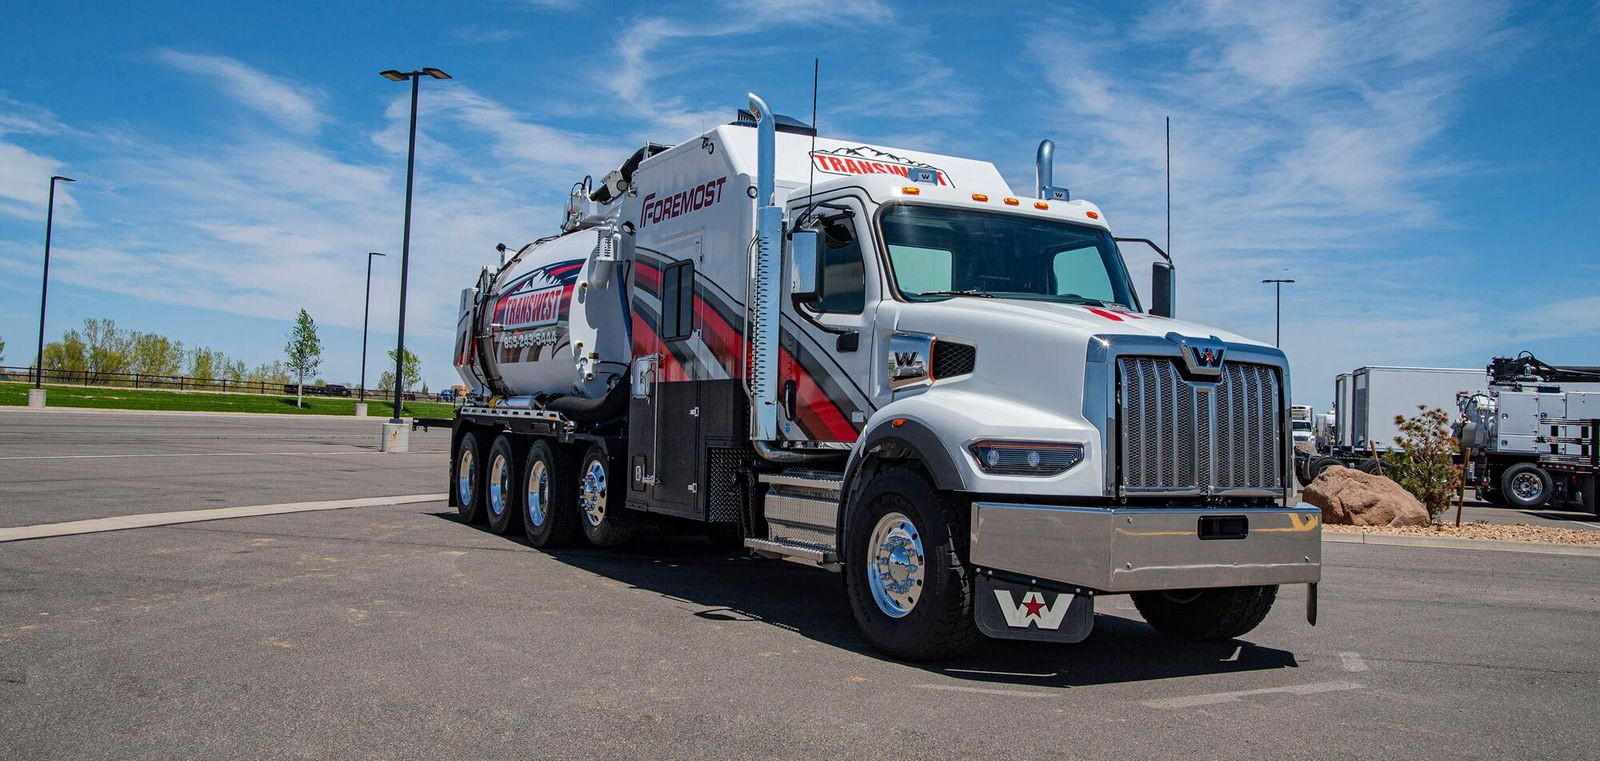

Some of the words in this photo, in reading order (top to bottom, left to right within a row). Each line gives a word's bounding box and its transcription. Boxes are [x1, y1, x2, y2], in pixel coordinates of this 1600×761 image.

[814, 154, 947, 187] TRANSWT
[640, 176, 727, 228] FOREMOST
[506, 289, 561, 325] TRANSWEST
[993, 589, 1075, 630] W
